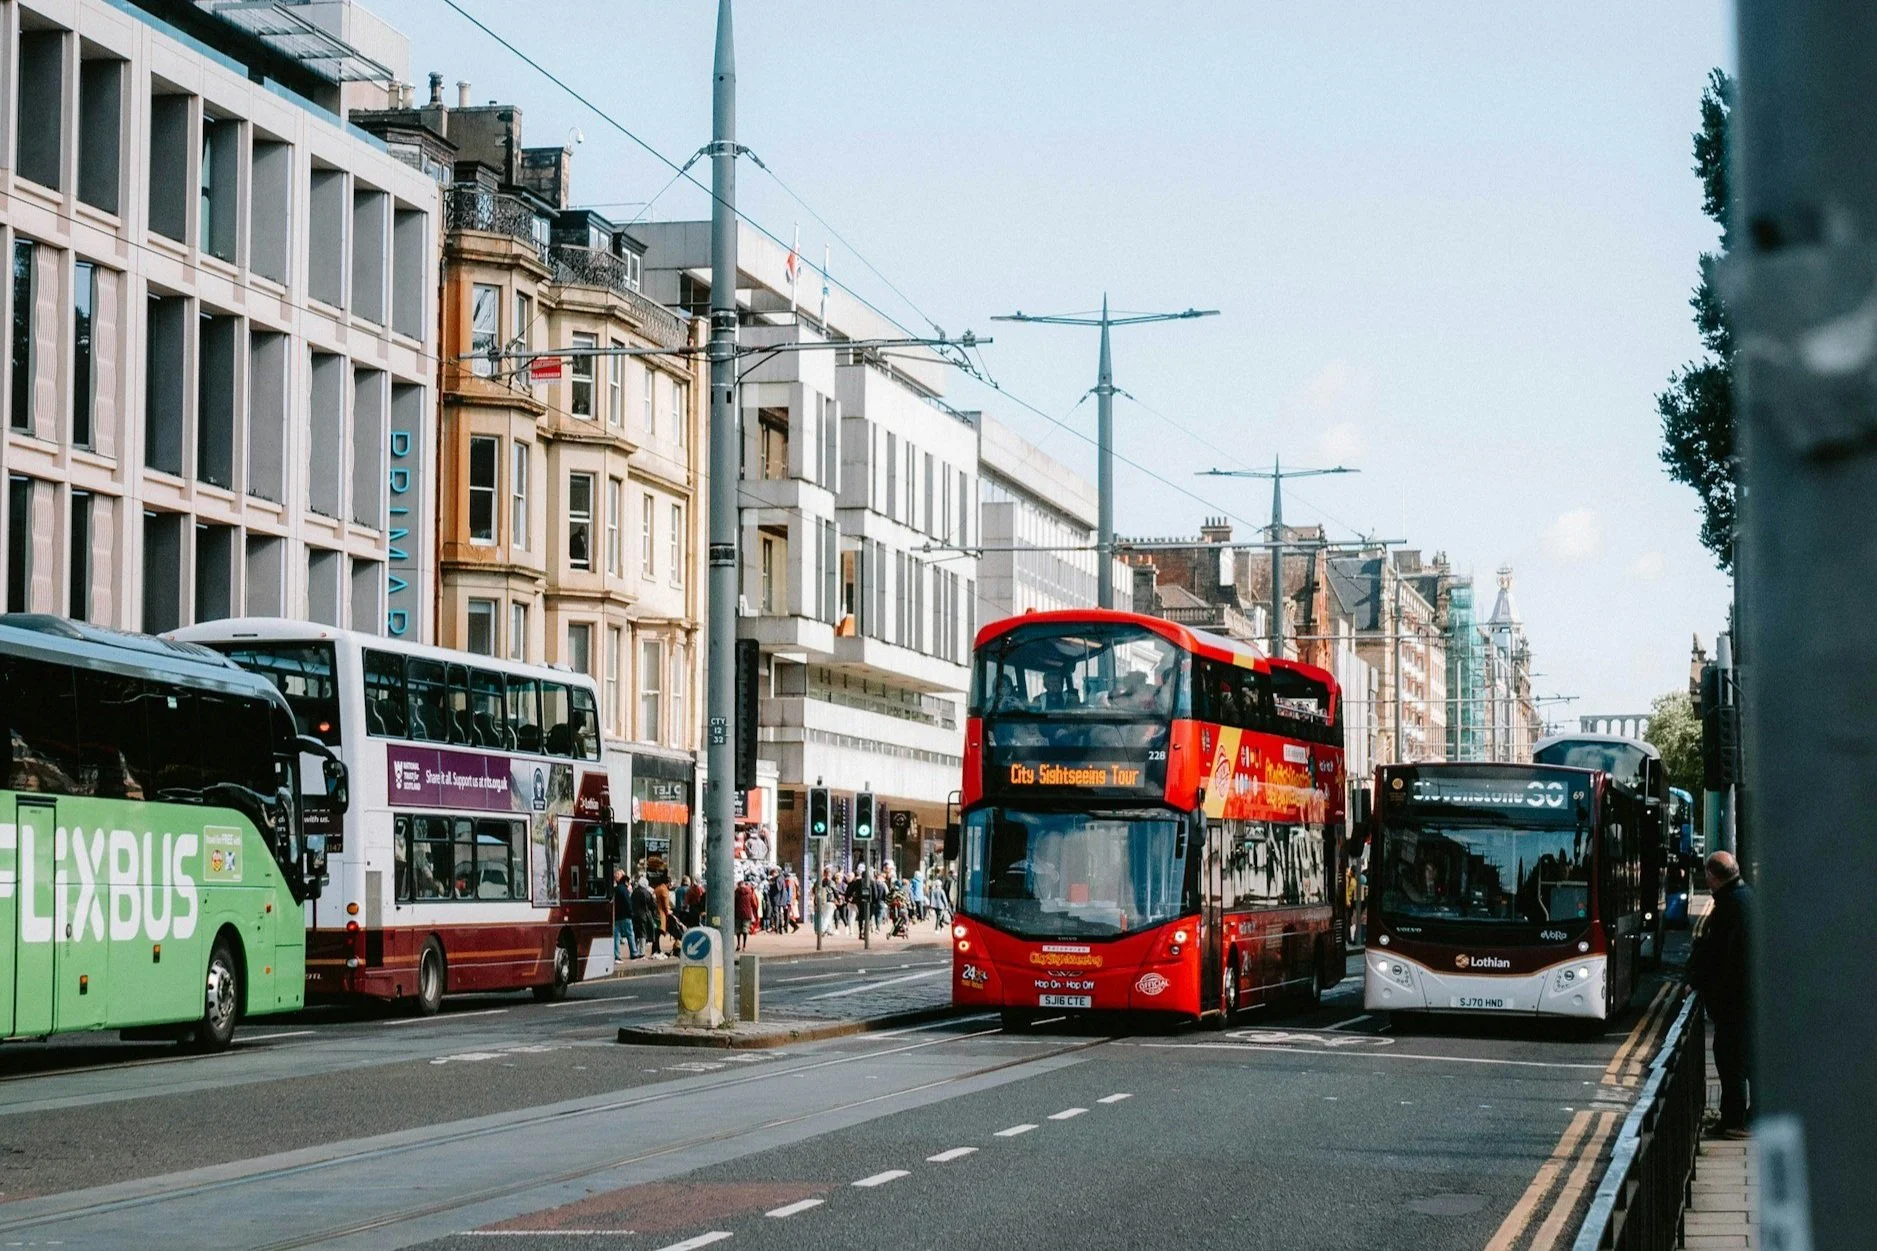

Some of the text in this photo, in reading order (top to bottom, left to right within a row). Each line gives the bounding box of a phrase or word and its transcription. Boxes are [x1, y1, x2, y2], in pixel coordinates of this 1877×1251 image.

[389, 431, 411, 635] PRIMAR
[710, 717, 726, 725] CTY
[713, 735, 724, 743] 32
[1148, 750, 1166, 760] 228
[1010, 762, 1139, 785] City Sightseeing Tour
[425, 769, 440, 784] Share
[453, 772, 473, 790] Support
[472, 777, 479, 787] us
[479, 776, 485, 788] at
[1572, 791, 1585, 800] 69
[303, 815, 319, 823] with
[1471, 956, 1510, 968] Lothian
[1034, 979, 1095, 990] Hop On Hop Off
[1044, 995, 1085, 1006] SJ16 CTE
[1460, 998, 1503, 1008] SJ70 HND
